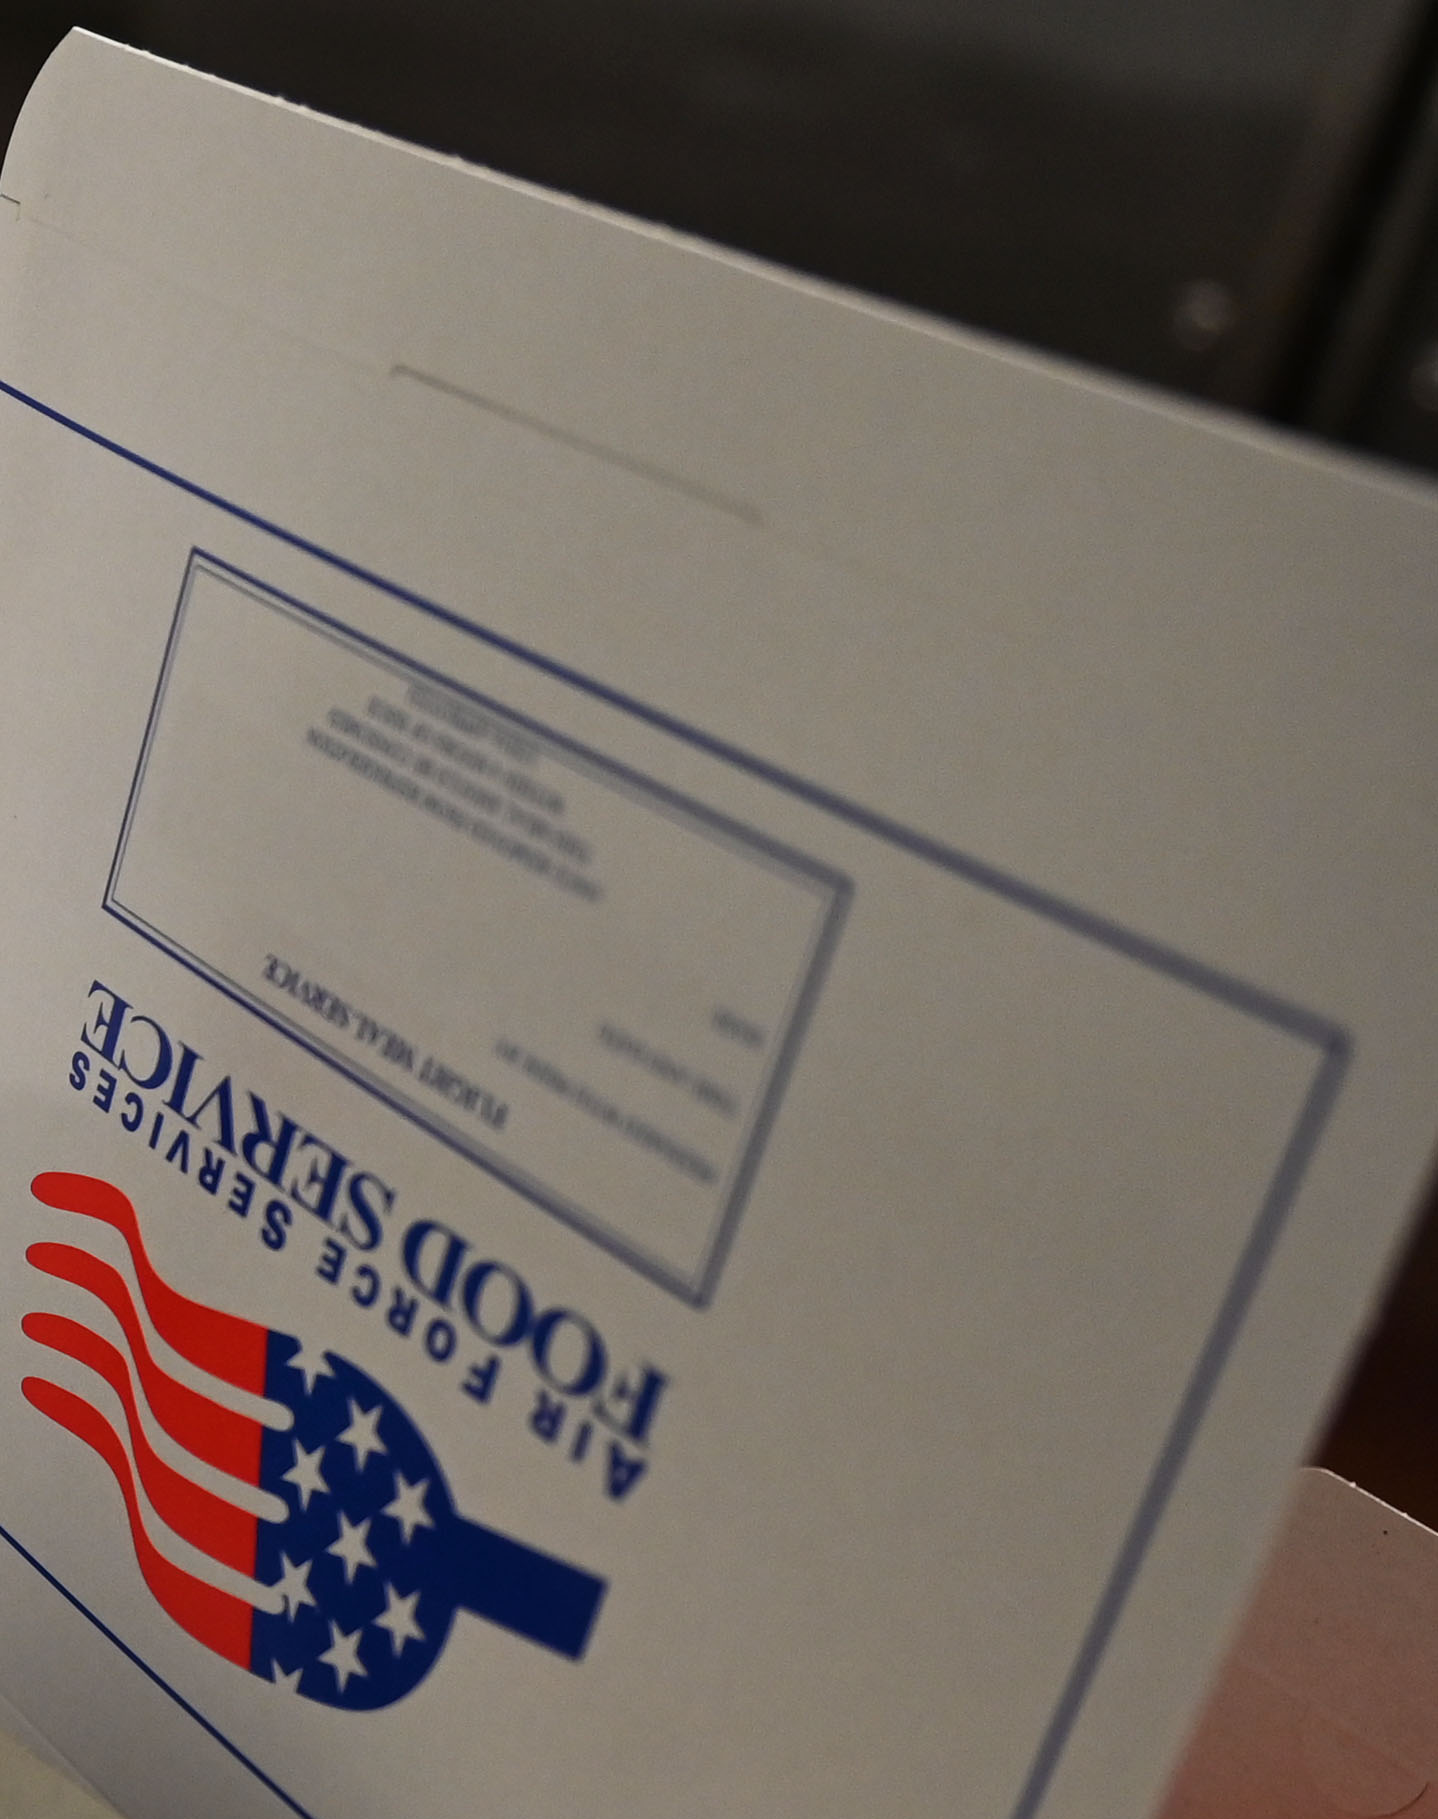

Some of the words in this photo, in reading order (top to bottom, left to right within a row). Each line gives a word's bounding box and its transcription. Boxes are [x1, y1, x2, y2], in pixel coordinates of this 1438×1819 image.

[262, 952, 351, 1031] SERVICE
[68, 1051, 294, 1251] SERVICES
[81, 979, 396, 1252] SERVICE
[316, 1238, 501, 1404] FORCE
[401, 1217, 671, 1446] FOOD
[528, 1391, 647, 1502] AIR
